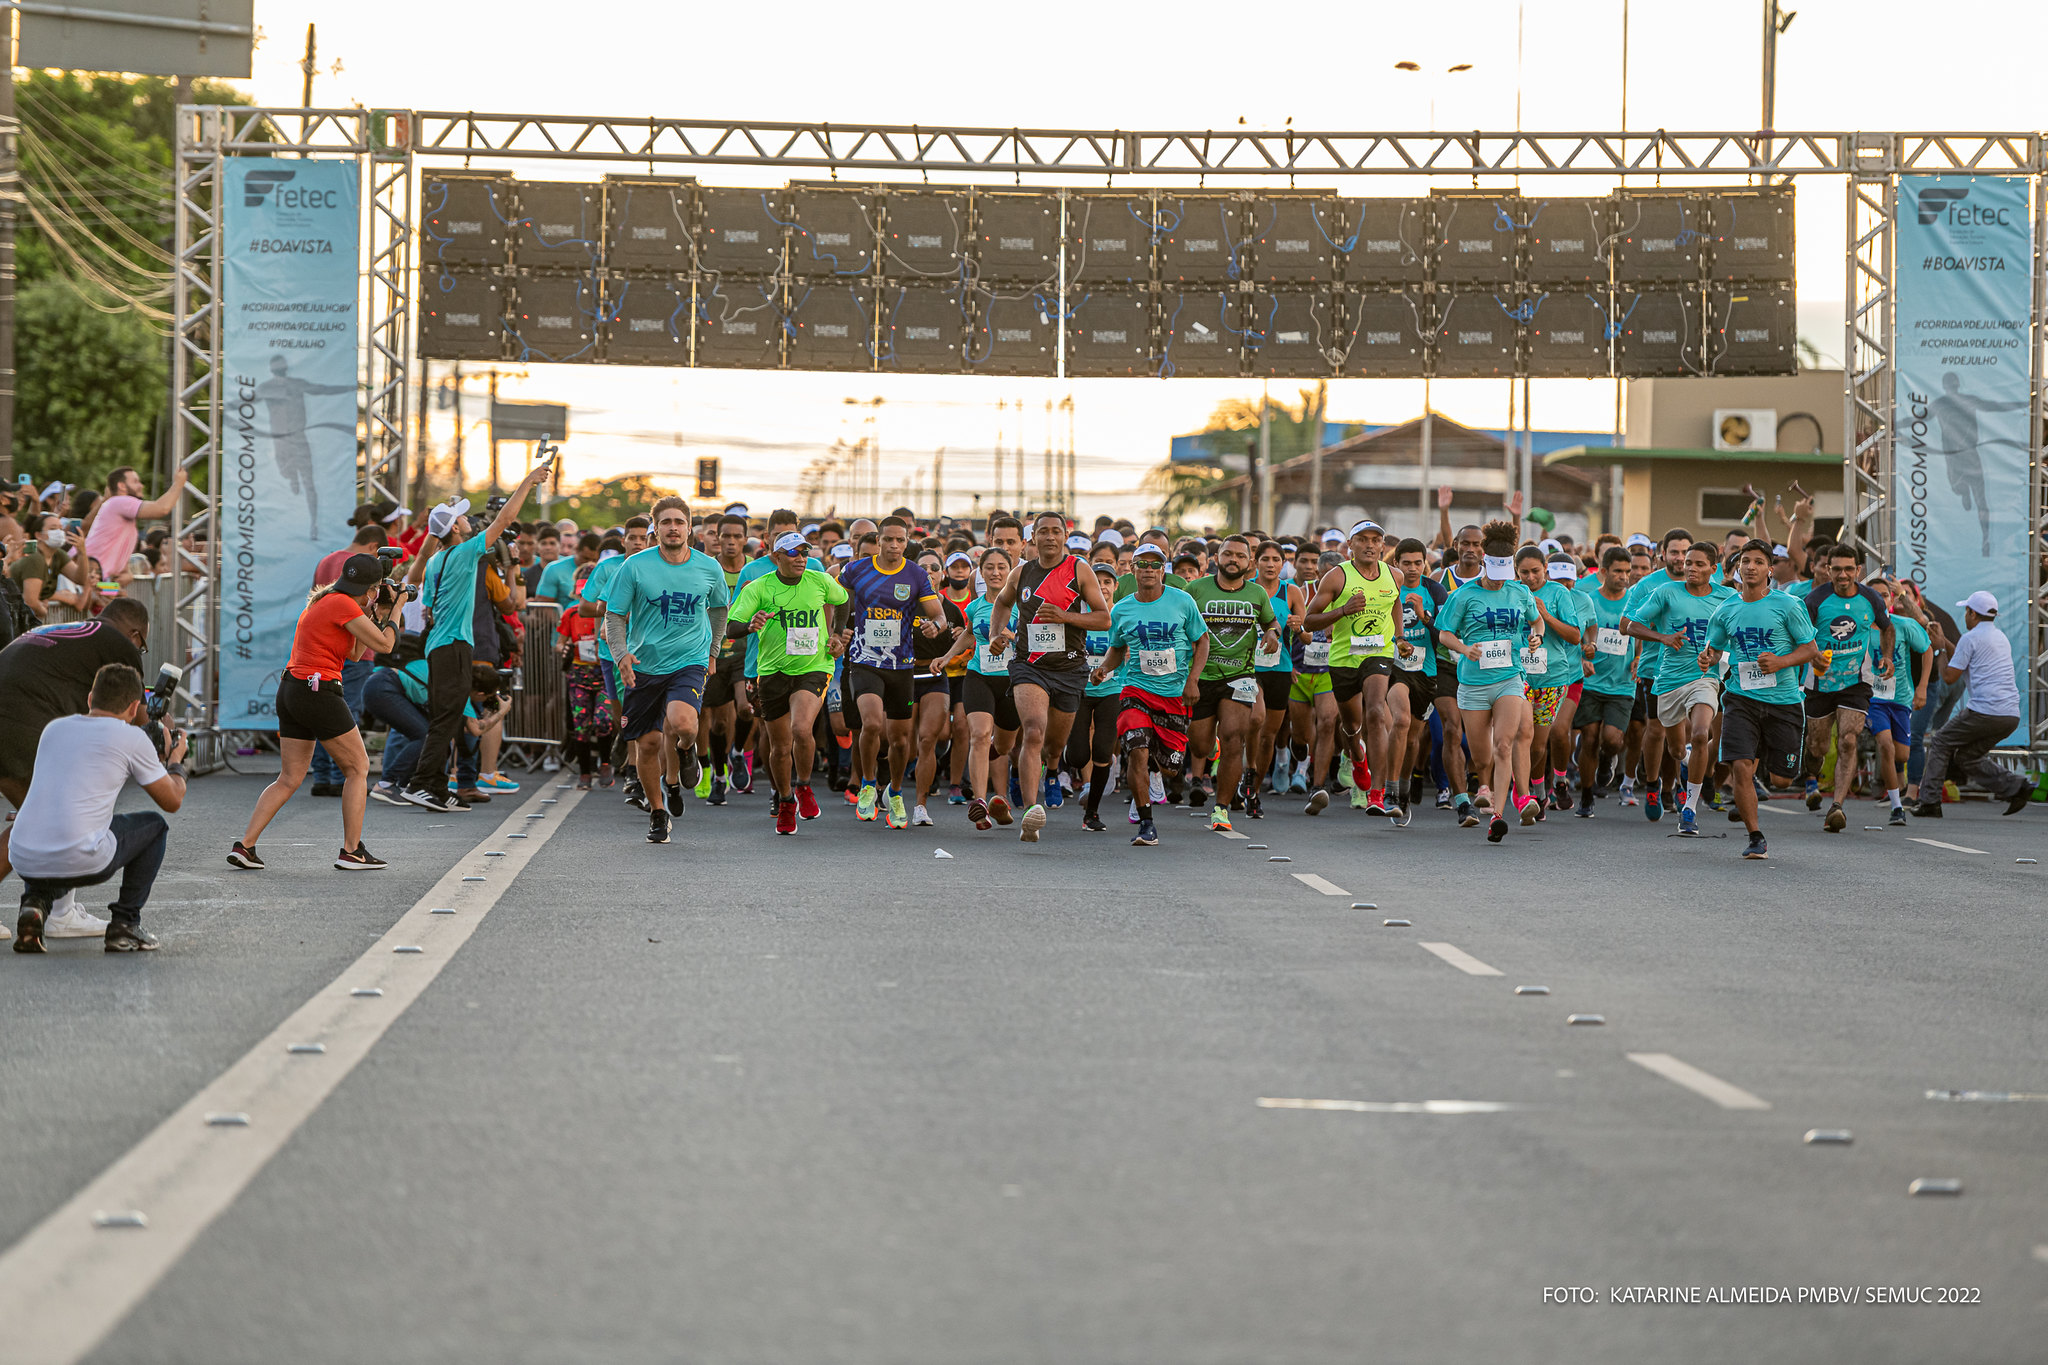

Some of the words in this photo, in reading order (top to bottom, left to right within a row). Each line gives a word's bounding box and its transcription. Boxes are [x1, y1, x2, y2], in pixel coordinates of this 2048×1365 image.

[275, 183, 336, 209] fetec
[1948, 201, 2009, 226] fetec
[249, 239, 333, 254] #BOAVISTA
[1922, 256, 2005, 271] #BOAVISTA
[1914, 319, 2025, 330] #CORRIDA9DEJULHOBV
[268, 339, 326, 349] #9DEJULHO
[1920, 338, 2019, 349] #CORRIDA9DEJULHO
[1941, 356, 1997, 366] #9DEJULHO
[236, 374, 256, 660] #COMPROMISSOCOMVOCÊ
[670, 591, 701, 616] 5K
[1207, 601, 1252, 616] GRUPO
[787, 609, 820, 627] 10K
[873, 629, 892, 637] 6321
[1035, 633, 1056, 642] 5828
[1148, 621, 1178, 642] 5K
[1745, 627, 1775, 649] 5K
[1486, 649, 1506, 658] 6664
[1147, 658, 1168, 667] 6594
